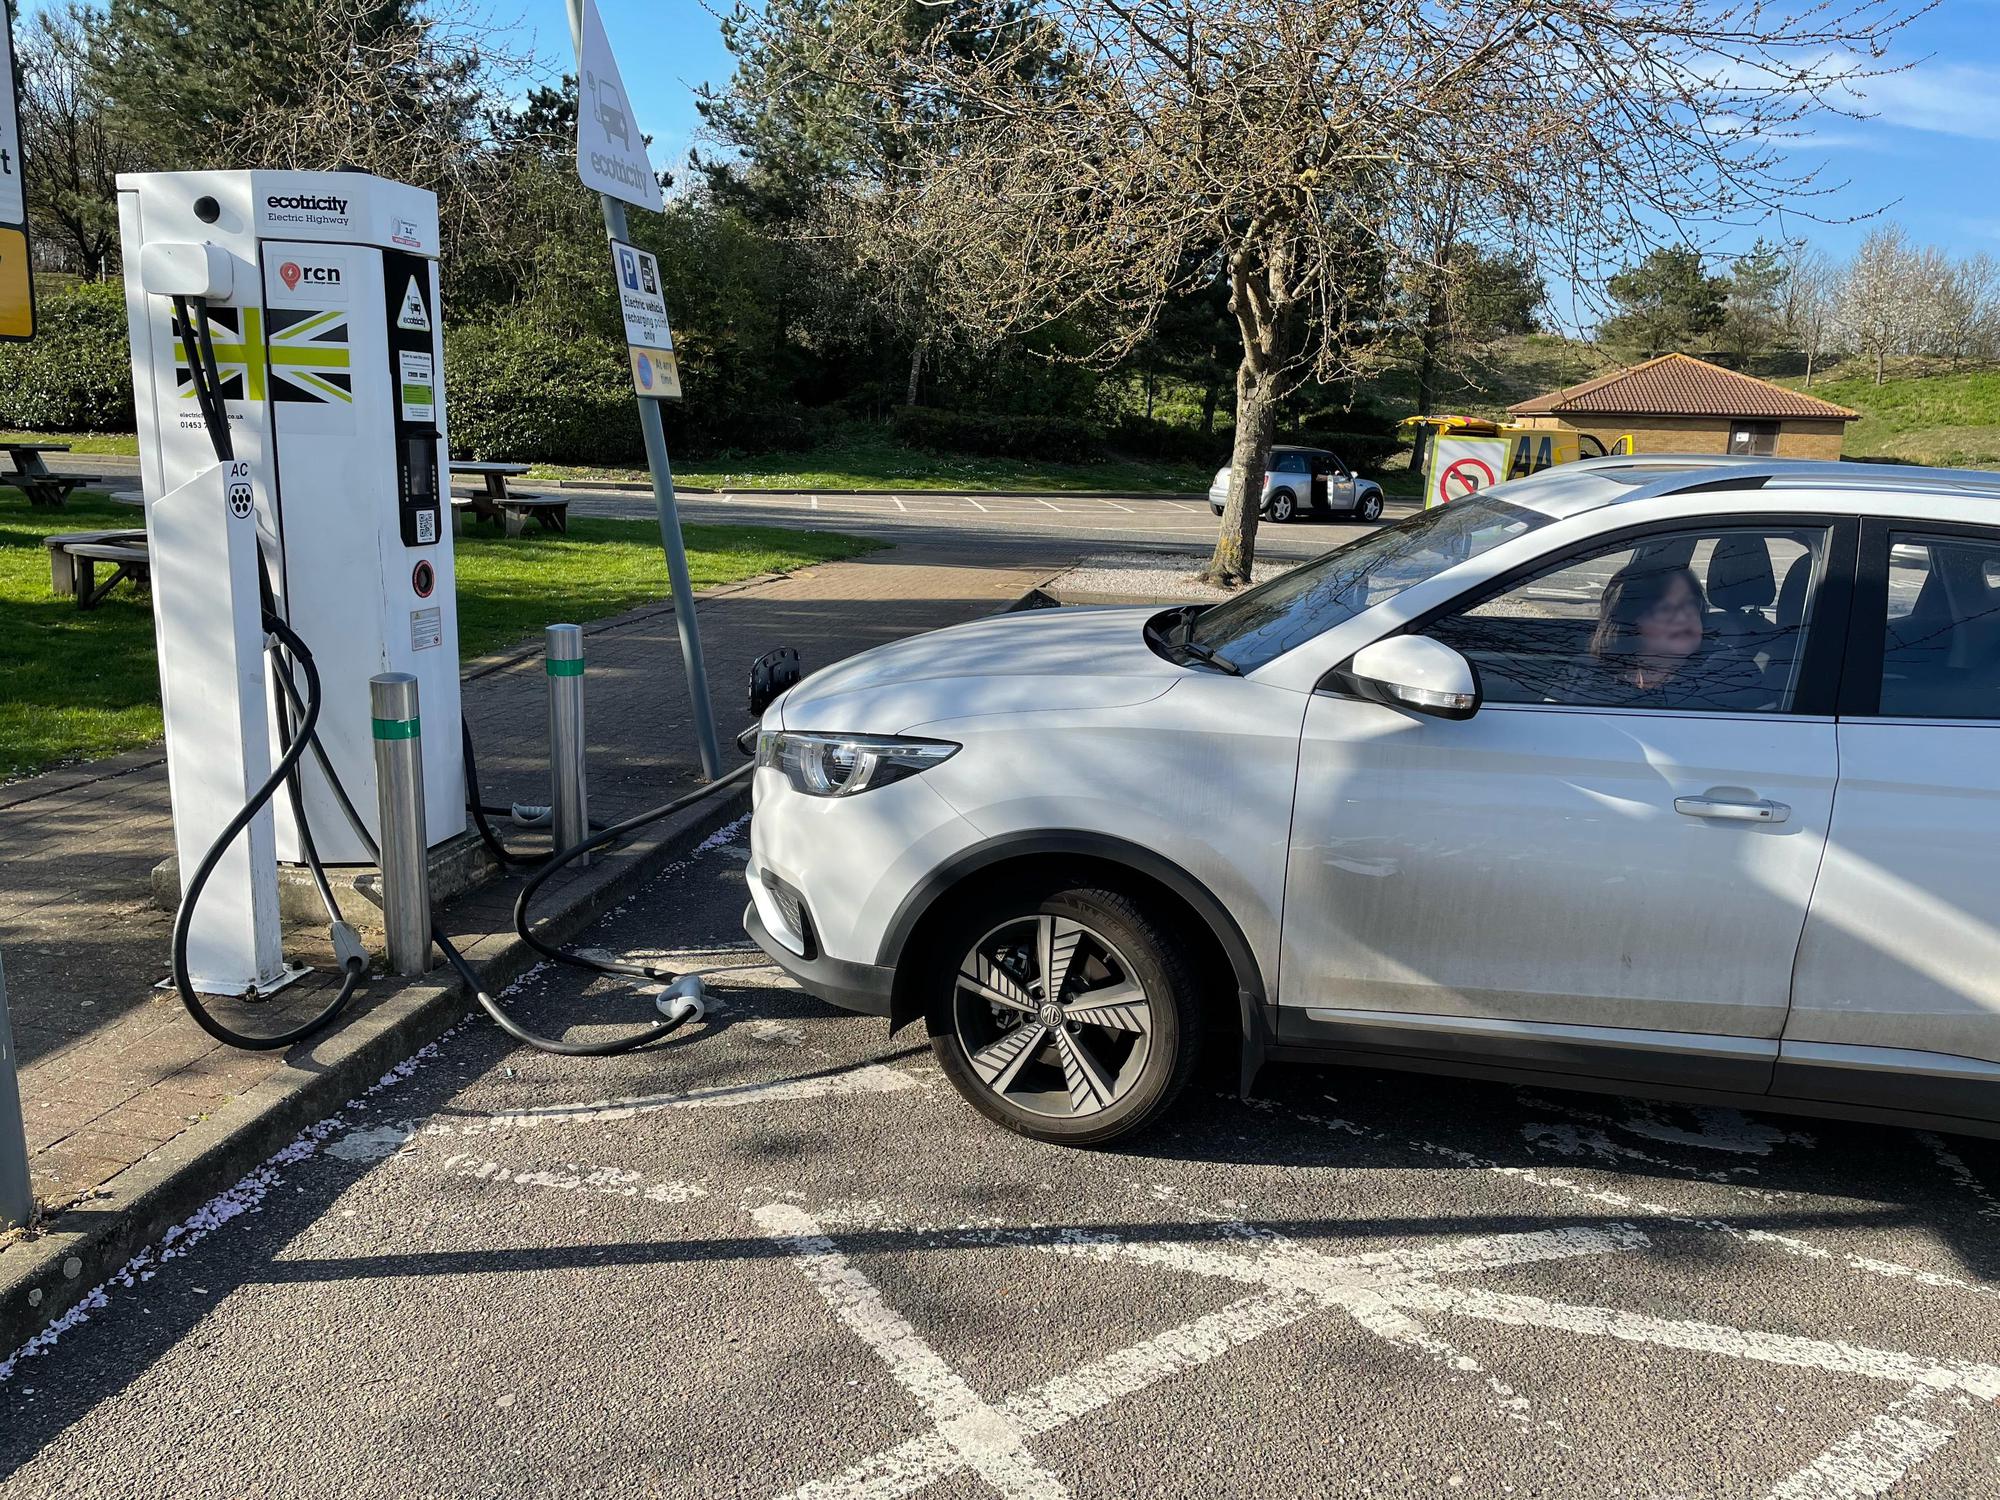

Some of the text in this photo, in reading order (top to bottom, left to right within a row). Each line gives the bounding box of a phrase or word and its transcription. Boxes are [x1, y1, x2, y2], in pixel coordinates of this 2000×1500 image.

[591, 151, 648, 198] ecotricity
[267, 194, 348, 215] ecotricity
[268, 213, 349, 226] Electric Highway
[303, 266, 341, 282] rcn
[623, 254, 634, 285] P
[624, 295, 664, 315] Electric vehicle
[625, 312, 668, 330] recharging point
[644, 330, 656, 343] only
[180, 421, 202, 429] 01453
[1506, 436, 1552, 481] AA
[230, 462, 248, 477] AC
[1042, 1005, 1060, 1025] MG
